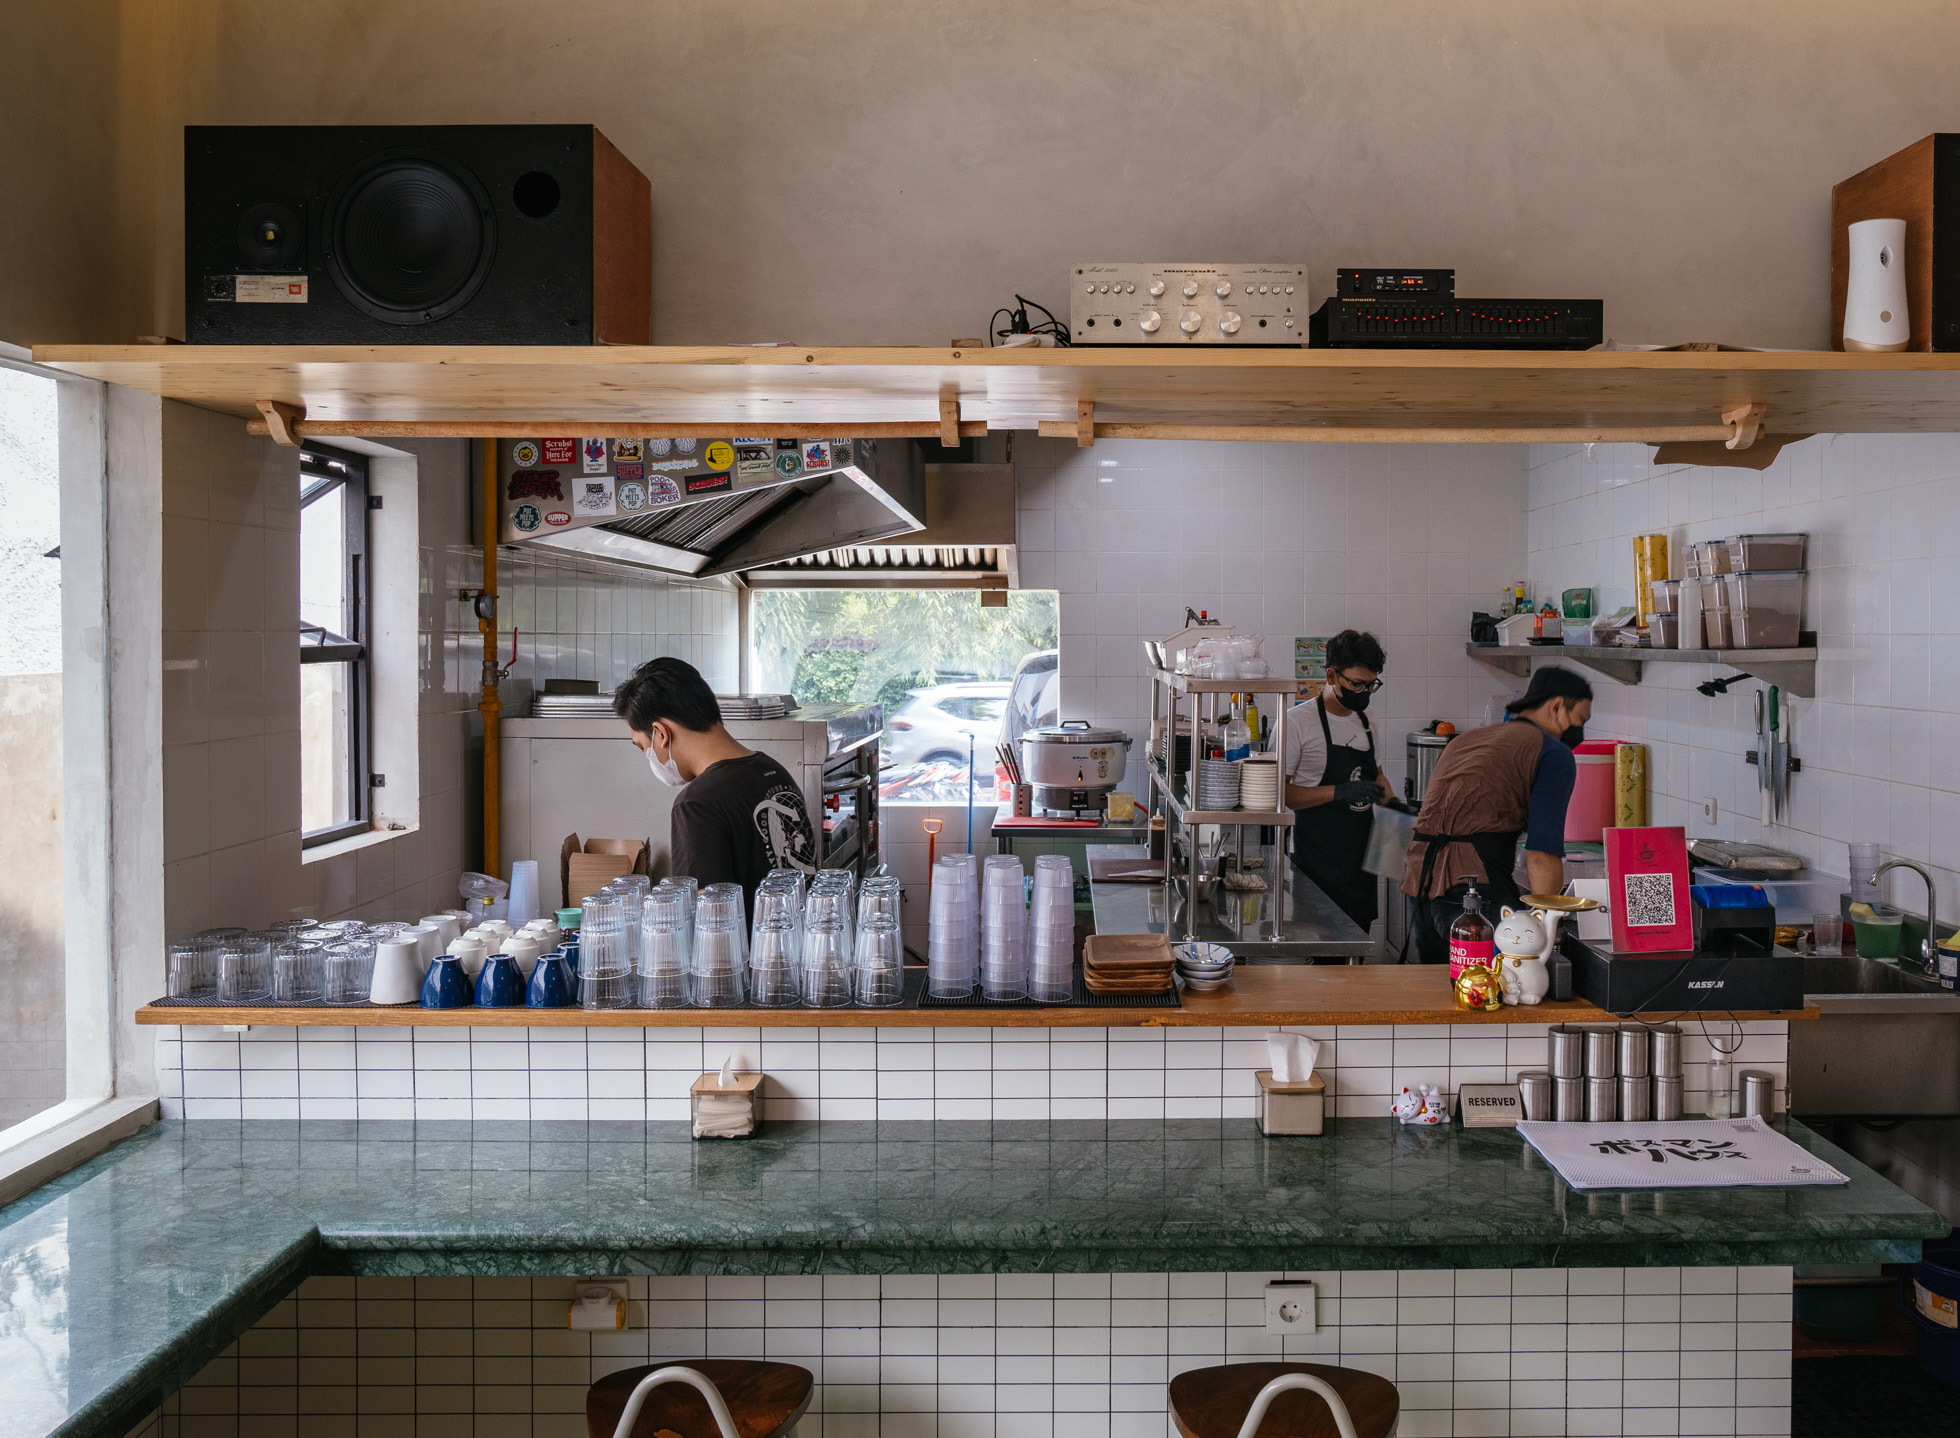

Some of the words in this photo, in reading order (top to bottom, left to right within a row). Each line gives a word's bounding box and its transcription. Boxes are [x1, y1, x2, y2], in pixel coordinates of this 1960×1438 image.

[545, 440, 572, 448] Scrubs!
[546, 451, 560, 459] Here
[561, 451, 572, 459] For
[617, 464, 642, 476] SUPPER
[649, 476, 679, 495] PODCAST
[688, 475, 728, 491] SCRUBS!
[625, 493, 640, 501] MEETS
[650, 494, 679, 505] BOKER
[520, 513, 534, 521] MEETS
[547, 513, 569, 521] SUPPER
[1688, 981, 1725, 989] KASSN
[1468, 1097, 1516, 1107] RESERVED
[1589, 1139, 1737, 1155] ボスマン
[1647, 1148, 1752, 1164] ハウス
